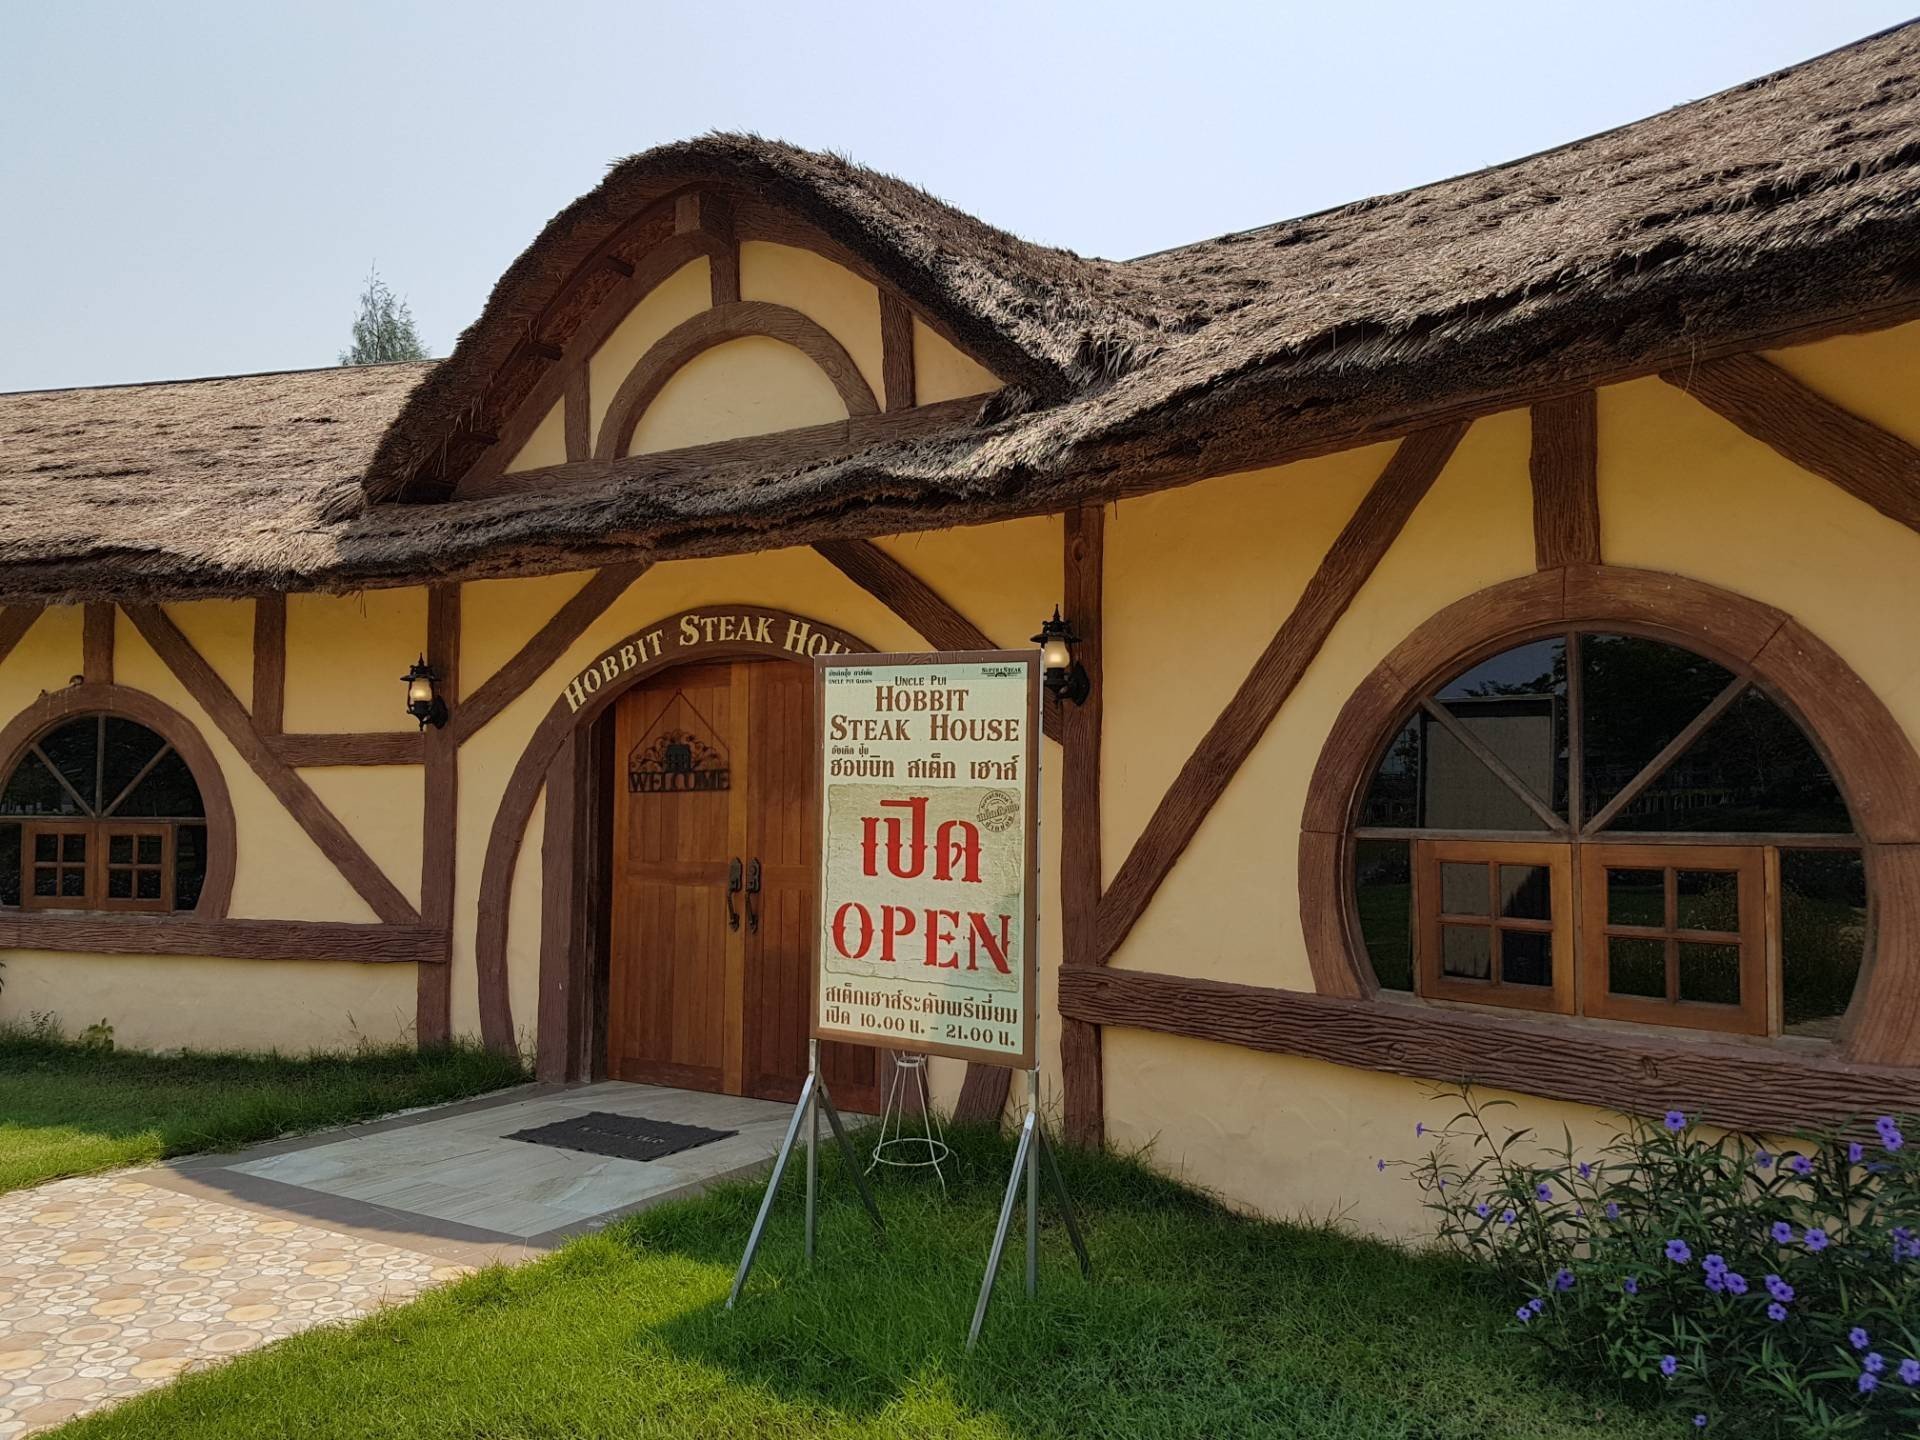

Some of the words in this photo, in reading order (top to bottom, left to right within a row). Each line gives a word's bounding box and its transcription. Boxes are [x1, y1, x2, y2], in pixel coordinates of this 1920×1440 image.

[562, 628, 665, 714] HOBBIT
[679, 614, 776, 647] STEAK
[895, 675, 925, 687] UNCLE
[930, 674, 947, 686] PUI
[875, 685, 969, 713] HOBBIT
[830, 714, 912, 742] STEAK
[929, 713, 1020, 742] HOUSE
[630, 769, 730, 792] WELCOME
[907, 752, 957, 779] สเต็ก
[969, 754, 1020, 781] เฮาส์
[860, 796, 983, 883] เปิด
[831, 902, 1013, 975] OPEN
[826, 1005, 851, 1025] เปิด
[860, 1012, 905, 1032] 10.00
[946, 1023, 994, 1044] 21.00
